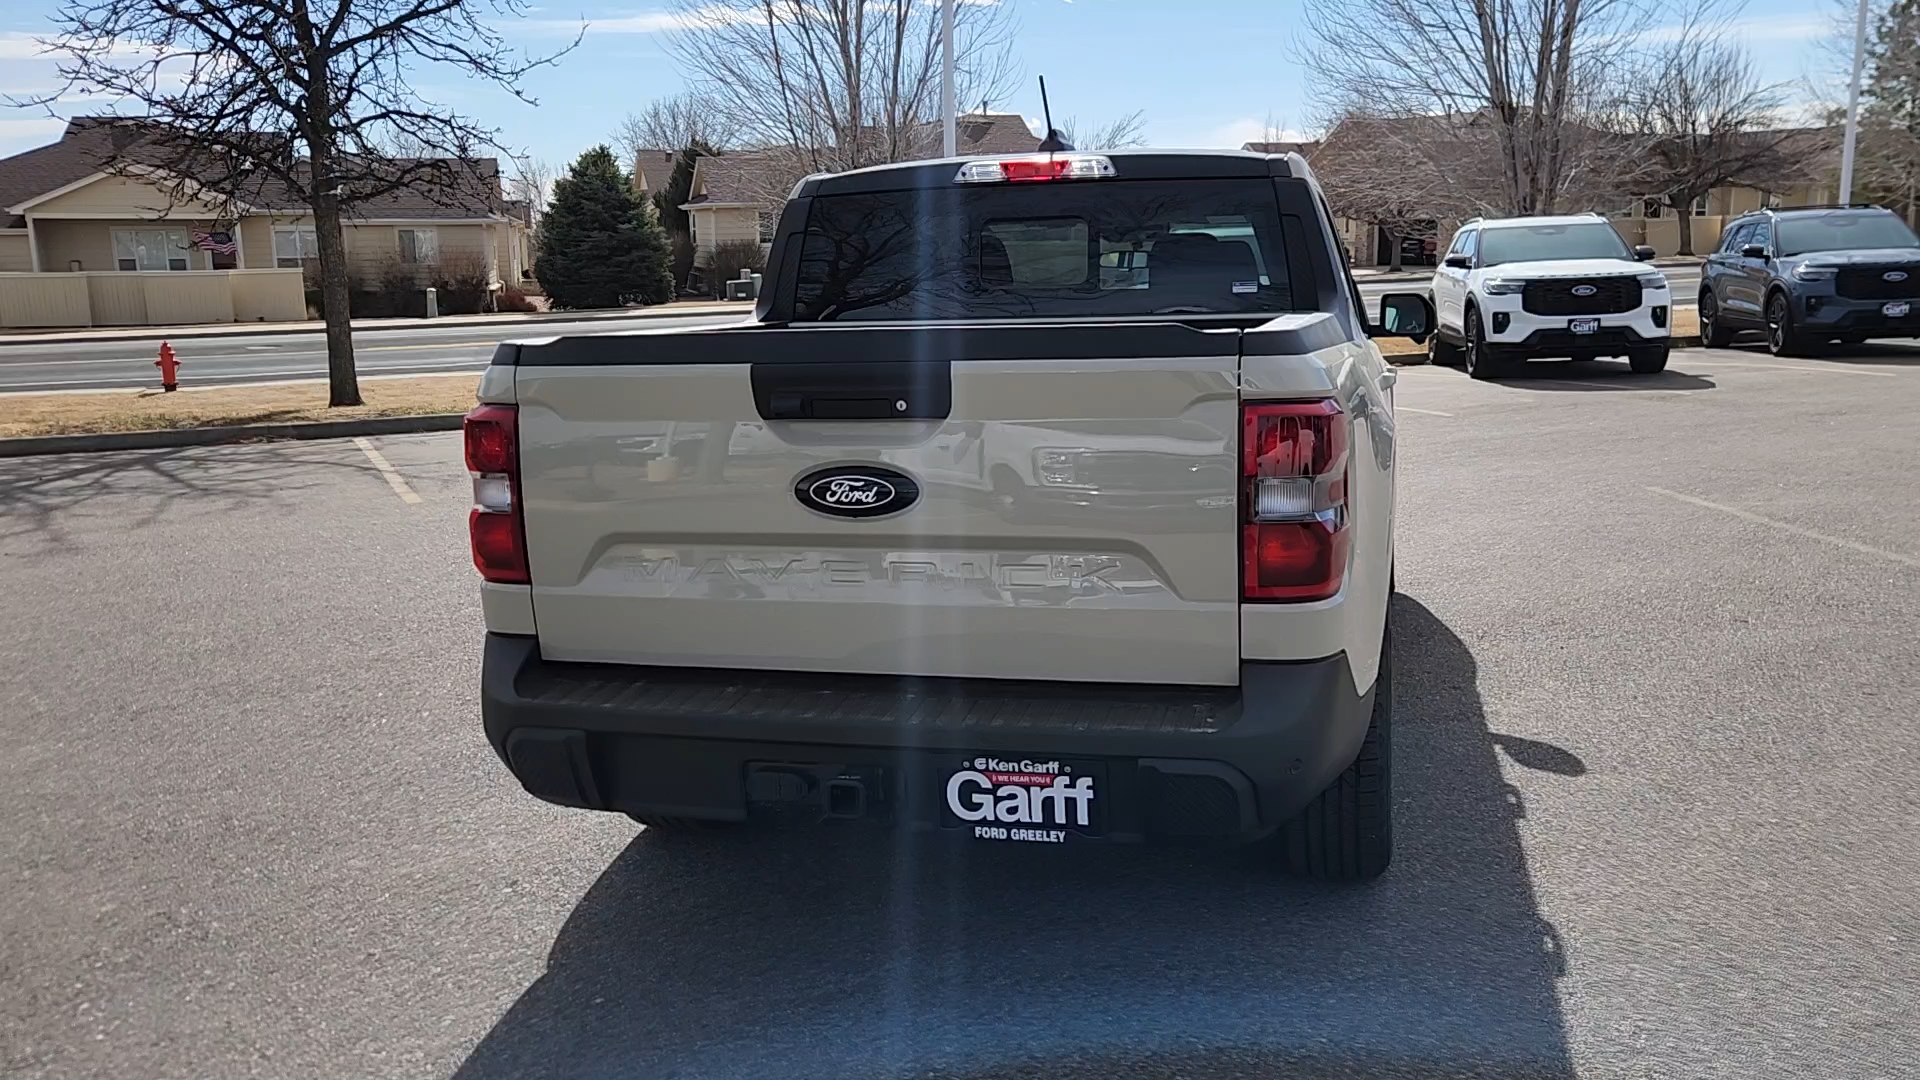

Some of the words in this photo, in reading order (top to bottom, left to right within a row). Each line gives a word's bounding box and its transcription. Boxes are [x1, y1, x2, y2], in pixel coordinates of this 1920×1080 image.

[1570, 320, 1598, 332] Garff
[825, 479, 878, 503] Ford
[624, 556, 1124, 594] MAVERICK
[988, 758, 1019, 773] Ken
[1020, 759, 1059, 774] Garff
[1010, 775, 1029, 783] HEAR
[1030, 776, 1046, 784] YOU
[946, 770, 1094, 826] Garff
[975, 827, 1007, 840] FORD
[1010, 830, 1066, 843] GREELEY
